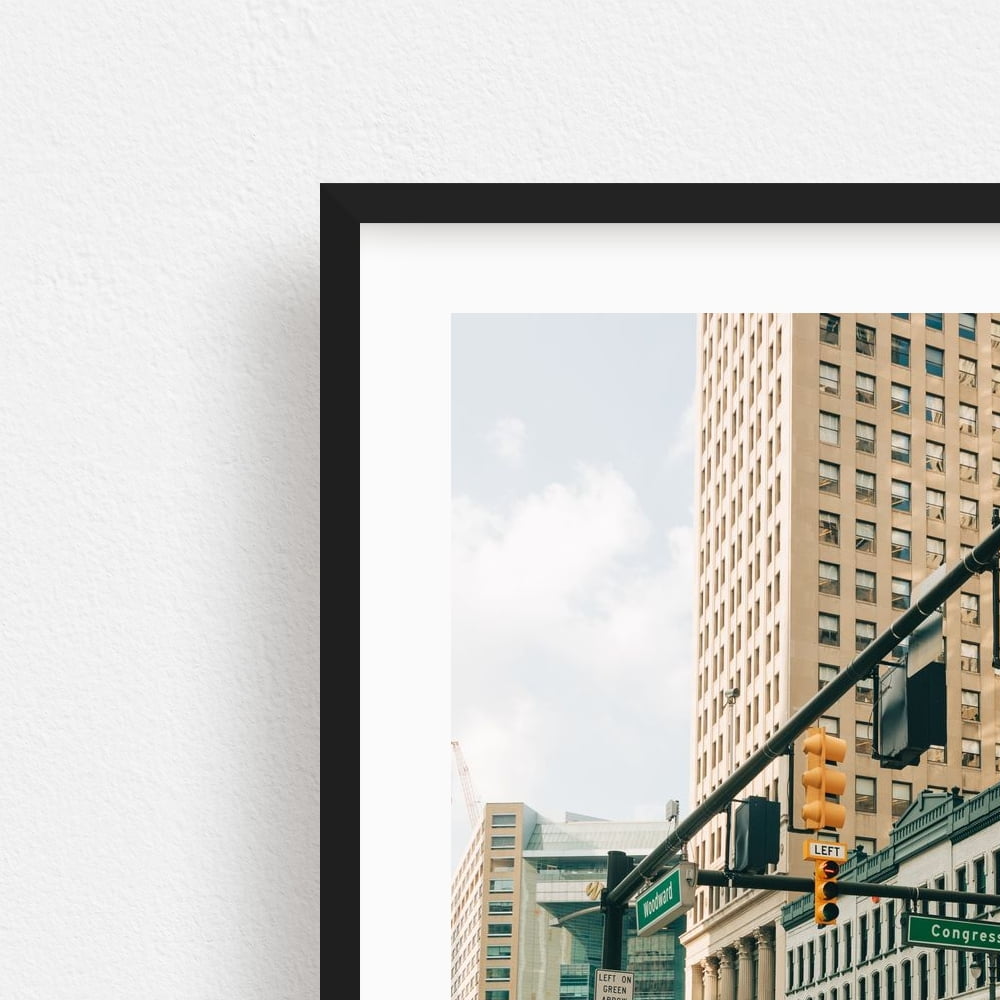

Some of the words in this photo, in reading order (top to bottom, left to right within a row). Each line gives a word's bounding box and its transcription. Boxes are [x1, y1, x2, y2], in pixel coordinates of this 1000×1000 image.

[814, 844, 840, 857] LEFT
[643, 881, 673, 918] Woodward
[598, 973, 616, 982] LEFT
[621, 976, 632, 984] ON
[602, 985, 627, 994] GREEN
